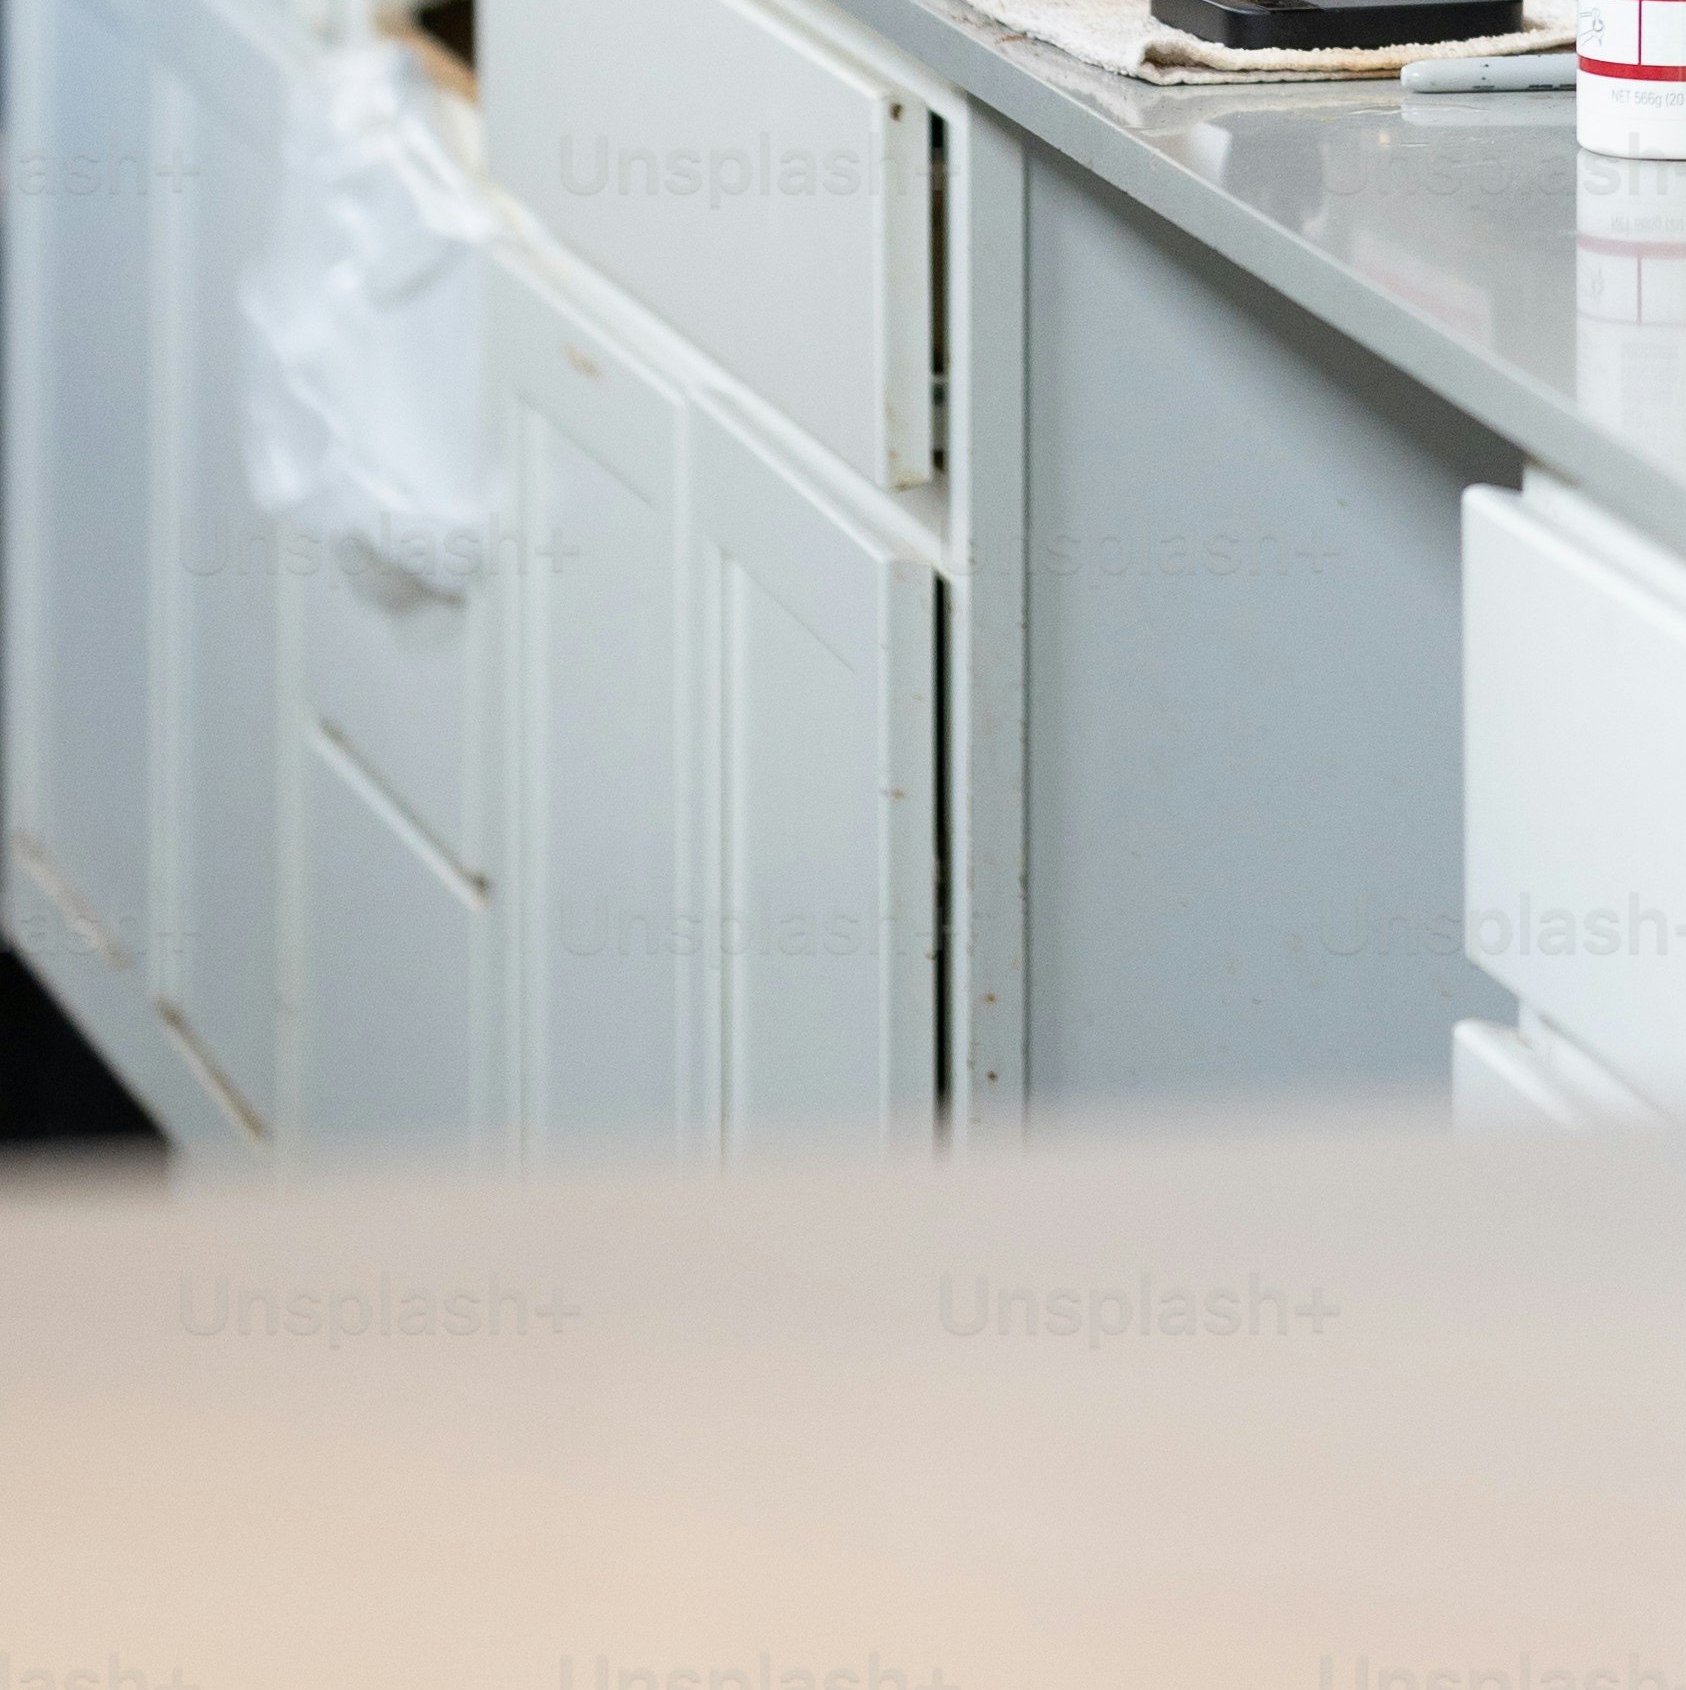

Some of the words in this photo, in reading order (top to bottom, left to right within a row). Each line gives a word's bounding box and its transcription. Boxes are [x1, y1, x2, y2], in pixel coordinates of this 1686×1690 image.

[1611, 89, 1630, 103] NET
[1634, 91, 1662, 108] 566g
[1665, 92, 1684, 107] (20
